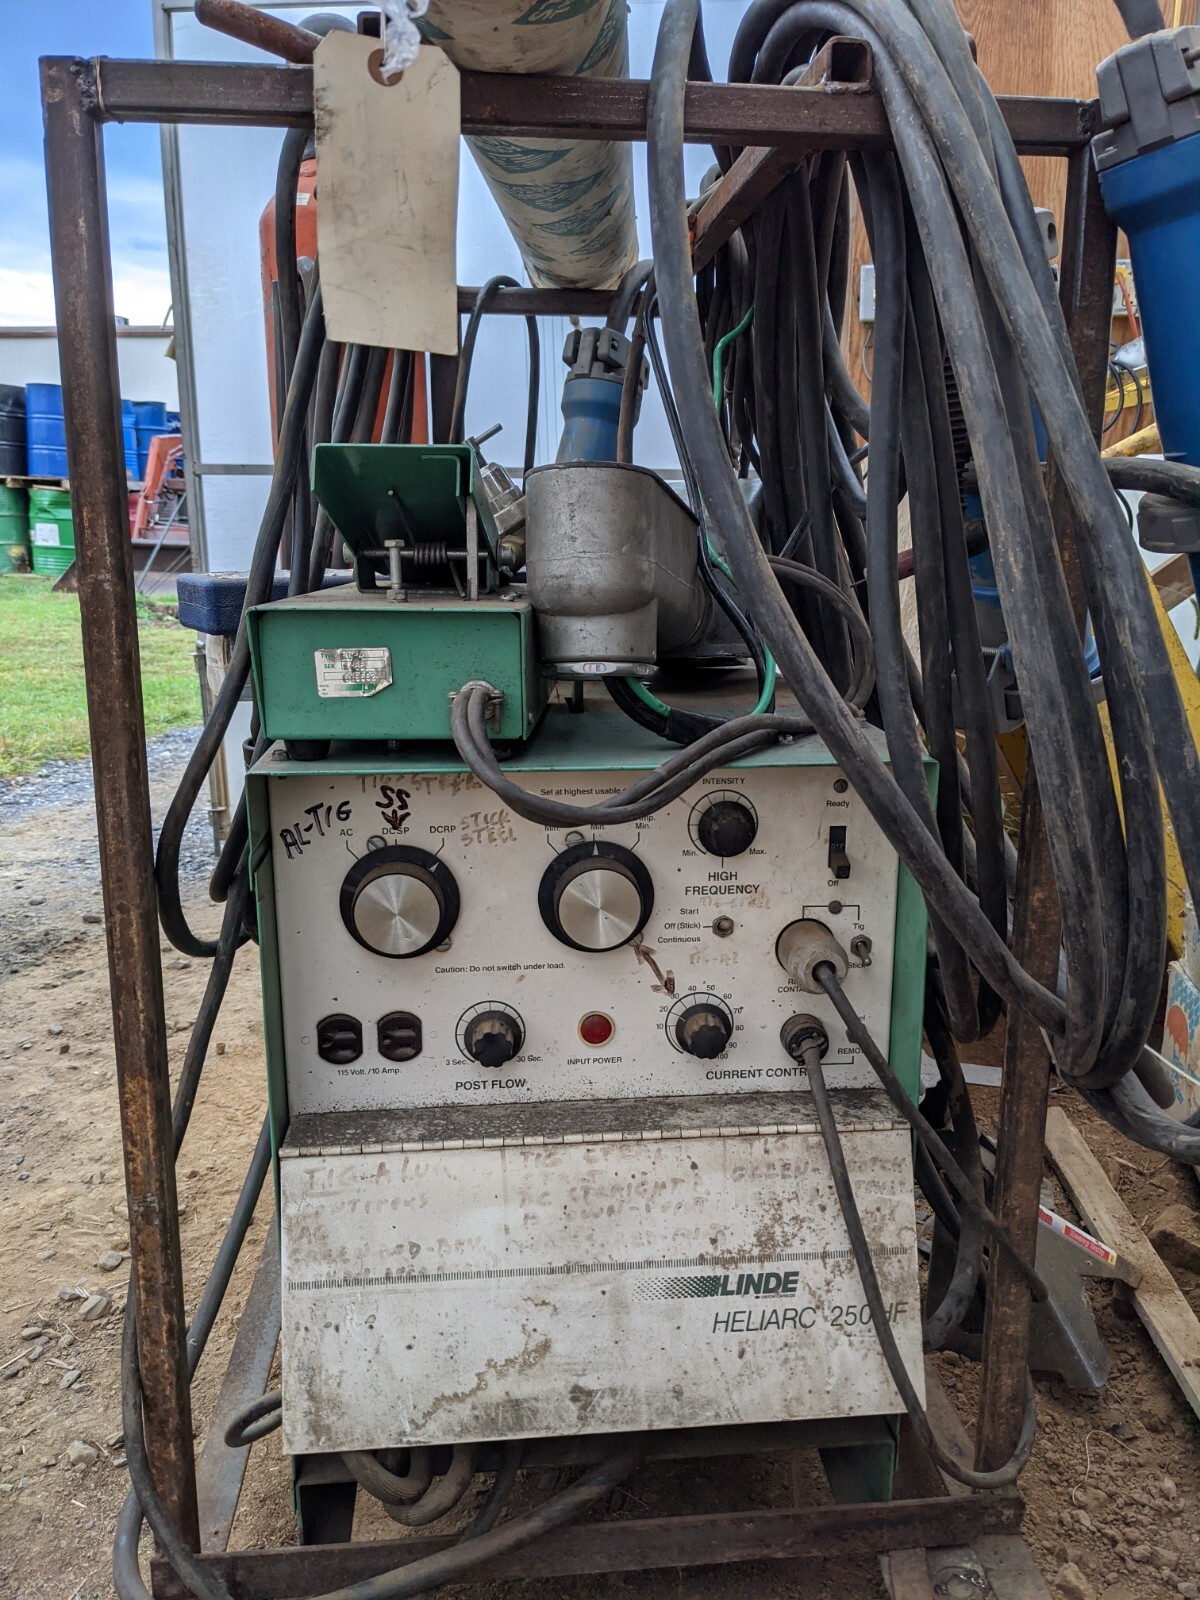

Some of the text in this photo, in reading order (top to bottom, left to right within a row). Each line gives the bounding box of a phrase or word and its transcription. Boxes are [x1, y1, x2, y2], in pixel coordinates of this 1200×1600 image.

[702, 777, 746, 785] INTENSITY
[540, 788, 554, 796] Set
[555, 788, 563, 796] at
[564, 788, 594, 797] highest
[595, 787, 621, 795] usable
[375, 785, 411, 811] SS
[826, 800, 851, 808] Ready
[429, 825, 457, 834] DCRP
[635, 822, 652, 830] Min.
[340, 828, 354, 837] AC
[381, 827, 410, 835] DCSP
[682, 849, 699, 857] Min.
[708, 871, 738, 881] HIGH
[684, 884, 760, 896] FREQUENCY
[663, 922, 701, 930] Off (Stick)
[852, 923, 866, 932] Tig
[657, 936, 701, 944] Continuous
[434, 966, 468, 974] Caution:
[469, 965, 481, 973] Do
[481, 964, 496, 972] not
[496, 963, 522, 971] switch
[523, 962, 546, 970] under
[837, 1047, 864, 1055] REMO
[451, 1058, 469, 1066] Sec.
[567, 1056, 623, 1066] INPUT POWER
[337, 1069, 350, 1077] 115
[382, 1067, 402, 1077] Amp.
[705, 1067, 808, 1080] CURRENT CONTR
[455, 1078, 526, 1091] POST FLOW
[720, 1271, 800, 1296] LINDE
[712, 1306, 817, 1334] HELIARC
[829, 1304, 872, 1327] 250
